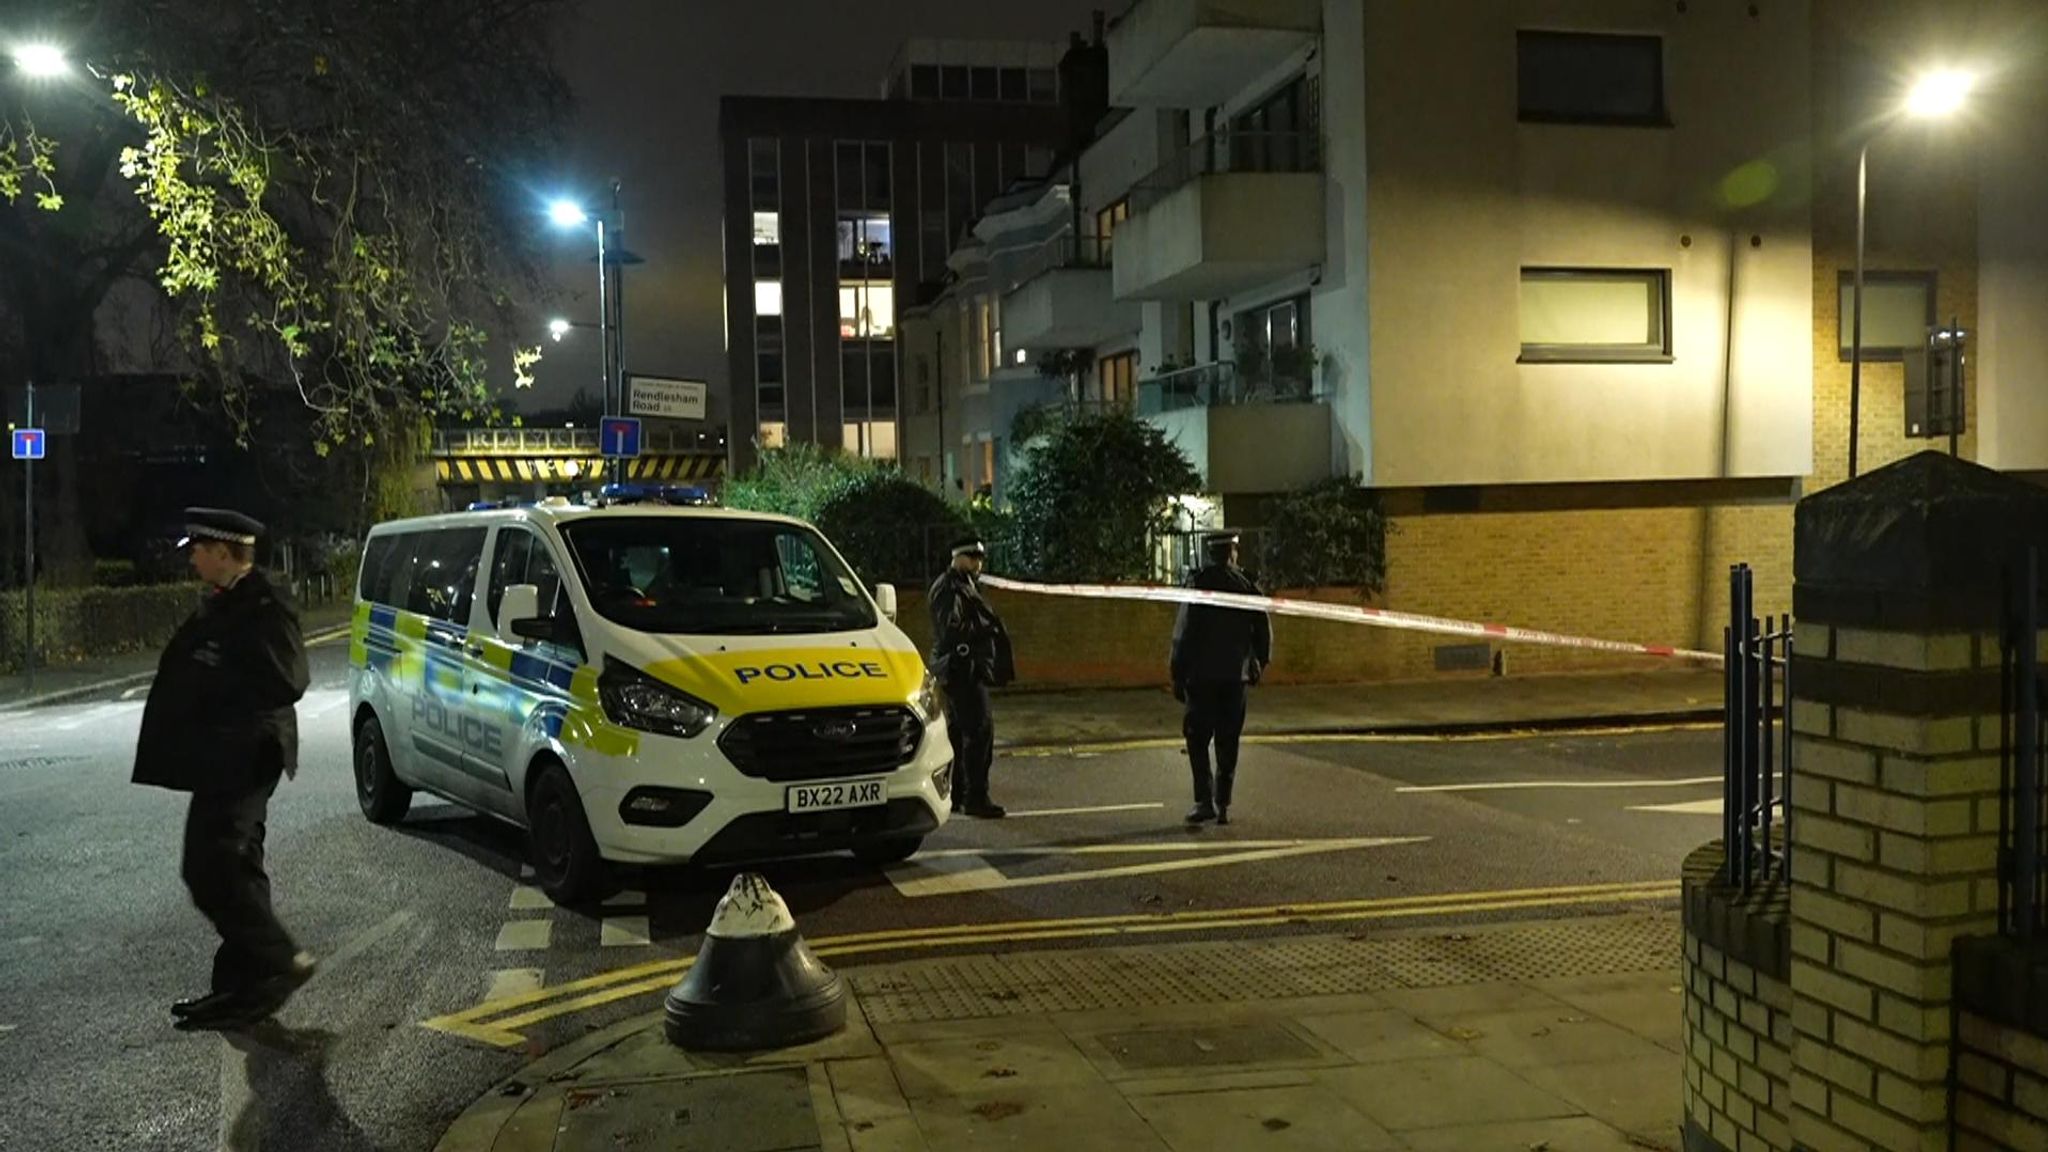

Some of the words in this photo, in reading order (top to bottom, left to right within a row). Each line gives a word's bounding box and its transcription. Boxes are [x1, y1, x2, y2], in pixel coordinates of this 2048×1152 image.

[633, 389, 698, 405] Rendlesham
[633, 400, 660, 412] Road
[734, 662, 888, 685] POLICE
[412, 695, 502, 758] POLICE
[797, 787, 843, 808] BX22
[849, 783, 881, 804] AXR
